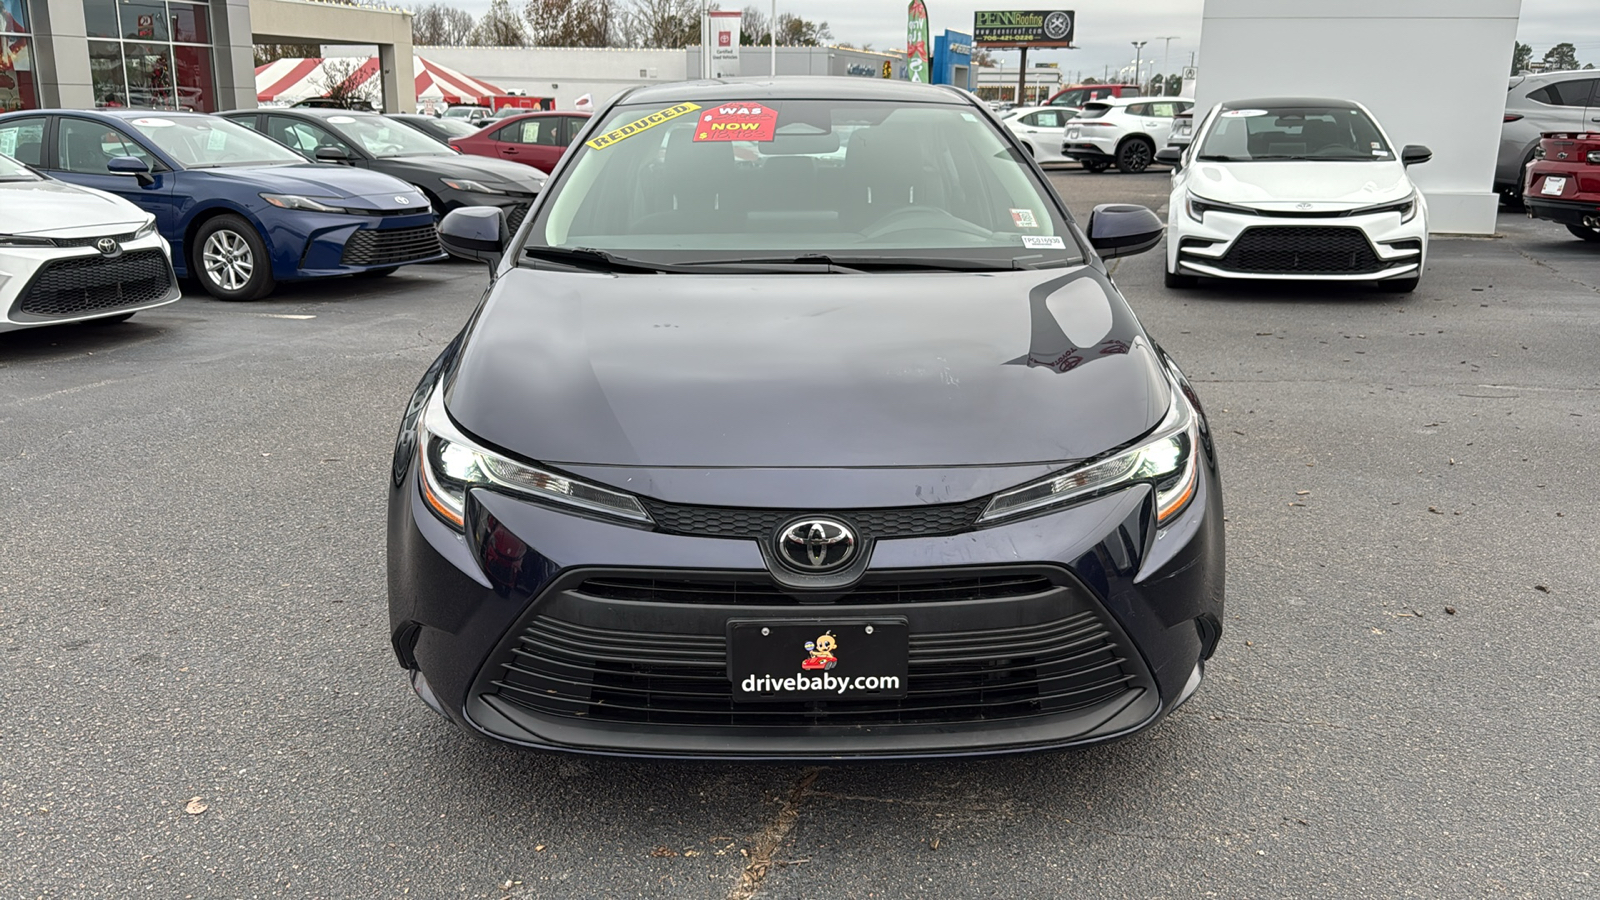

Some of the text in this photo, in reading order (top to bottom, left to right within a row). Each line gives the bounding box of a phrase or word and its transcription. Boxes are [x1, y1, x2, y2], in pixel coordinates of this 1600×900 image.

[976, 12, 1021, 25] PENN
[1016, 13, 1043, 27] Roofing
[719, 107, 762, 115] WAS
[593, 105, 691, 147] REDUCED
[711, 122, 760, 131] NOW
[699, 132, 708, 140] $
[741, 672, 900, 695] drivebaby.com
